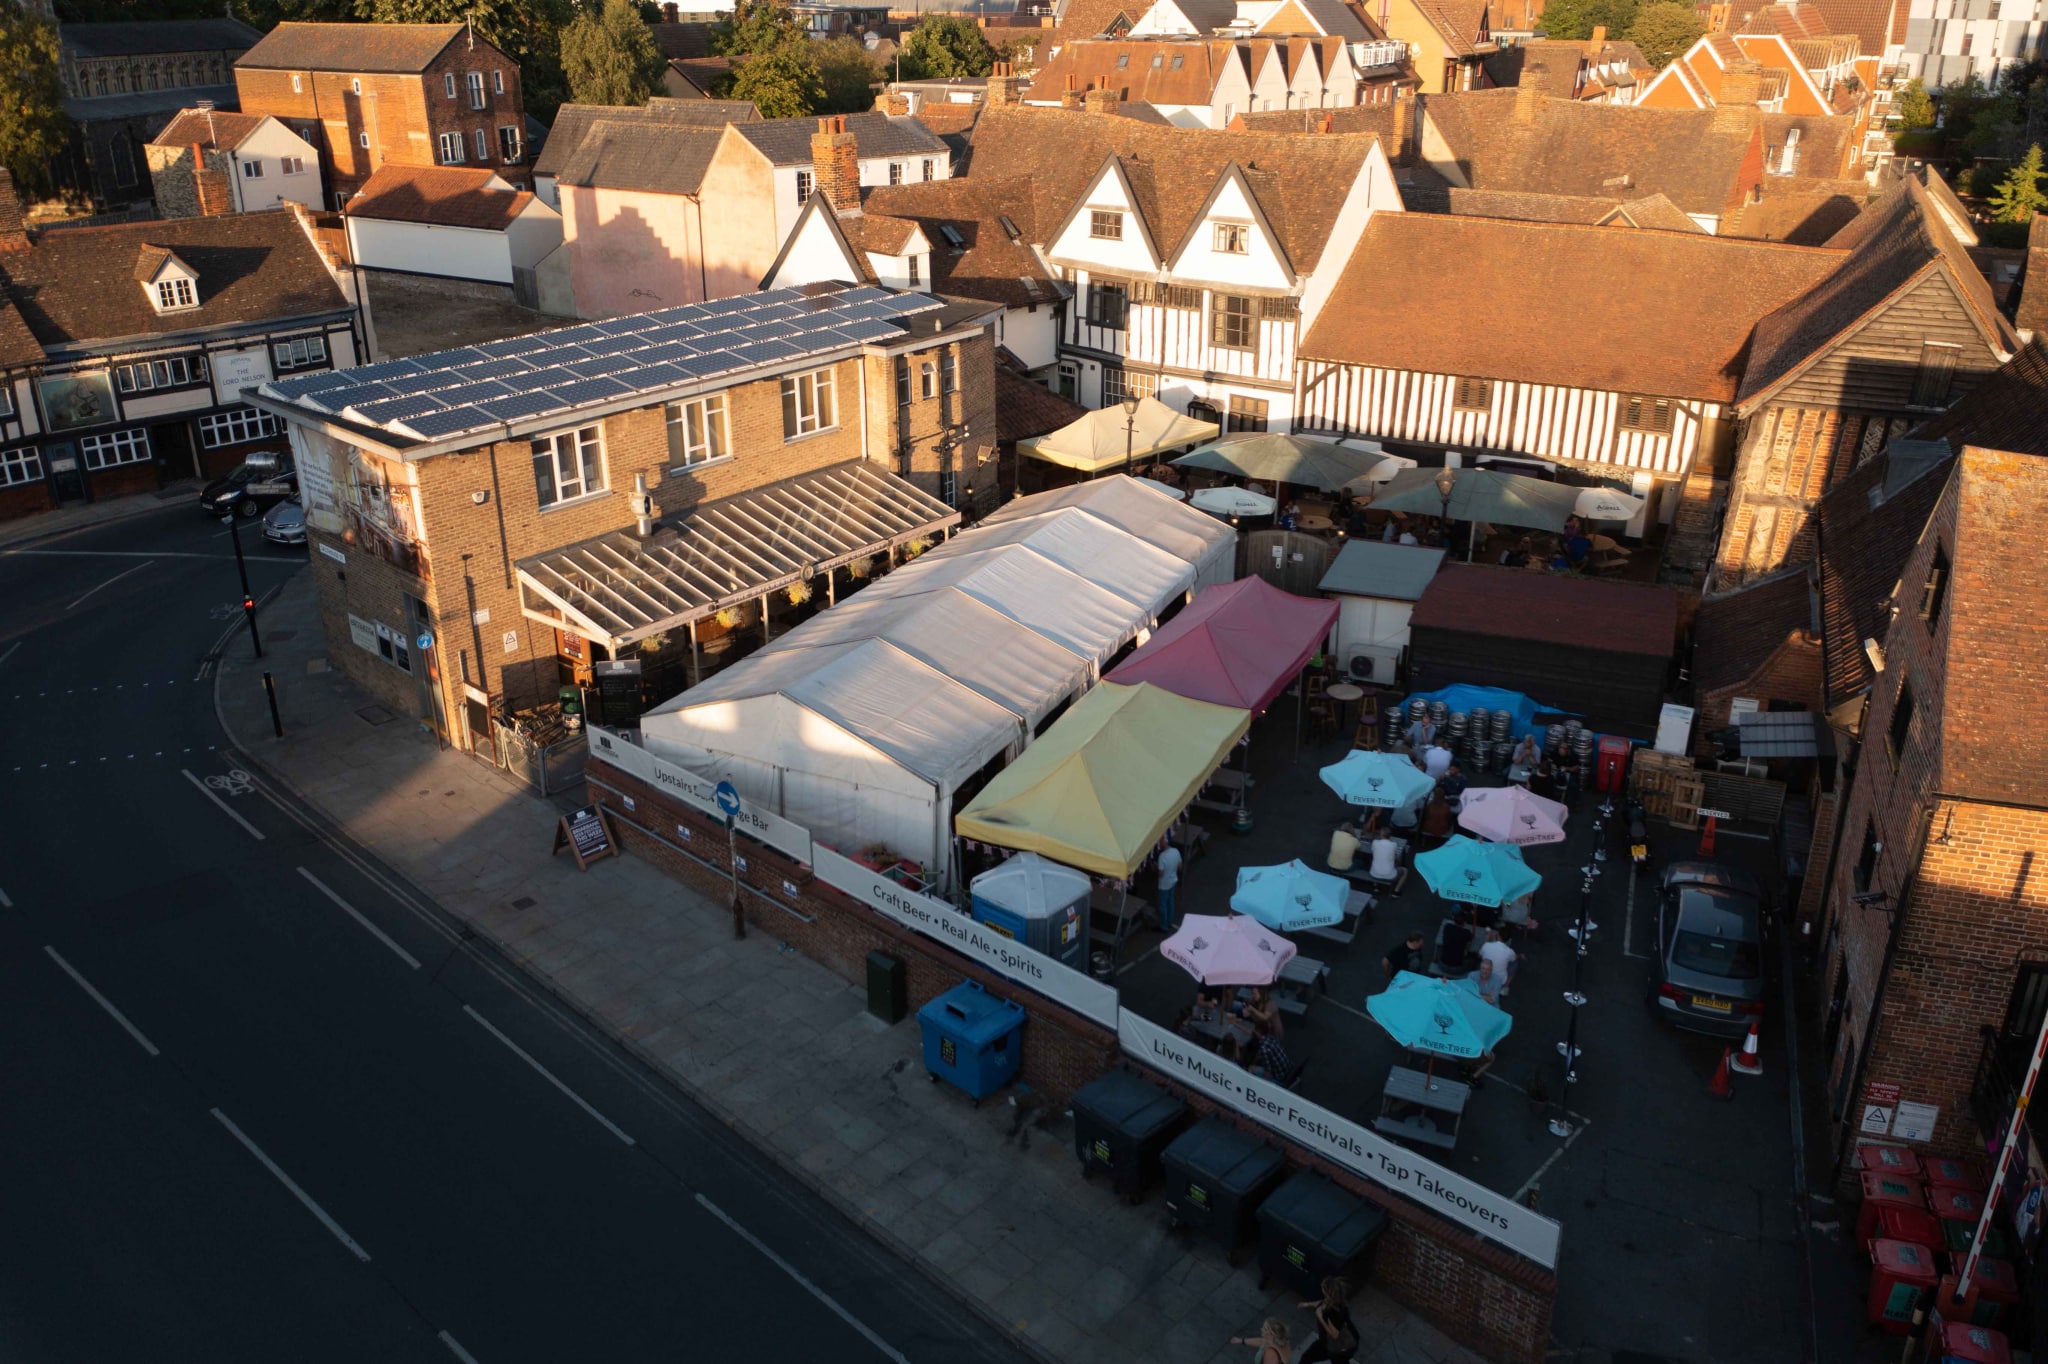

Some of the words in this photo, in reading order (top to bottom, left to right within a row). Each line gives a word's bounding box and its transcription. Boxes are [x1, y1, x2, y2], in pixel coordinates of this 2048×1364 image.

[222, 377, 240, 386] LORD
[242, 374, 266, 382] NELSON
[654, 767, 693, 794] Upstairs
[752, 814, 769, 832] Bar
[1353, 795, 1397, 806] FEVER-TREE
[1514, 833, 1556, 844] FEVER-TREE
[1446, 889, 1494, 904] FEVER-TREE
[1287, 916, 1332, 928] FEVER-TREE
[872, 884, 901, 909] Craft
[902, 900, 932, 924] Beer
[940, 918, 968, 943] Real
[970, 932, 991, 954] Ale
[1000, 949, 1043, 980] Spirits
[1166, 948, 1200, 976] FEVER-TREE
[1419, 1036, 1473, 1055] FEVER-TREE
[1871, 1081, 1900, 1091] WARNING
[1153, 1038, 1184, 1065] Live
[1187, 1056, 1233, 1092] Music
[1246, 1086, 1286, 1117] Beer
[1288, 1108, 1363, 1158] Festivals
[1378, 1152, 1410, 1180] Tap
[1414, 1169, 1509, 1230] Takeovers
